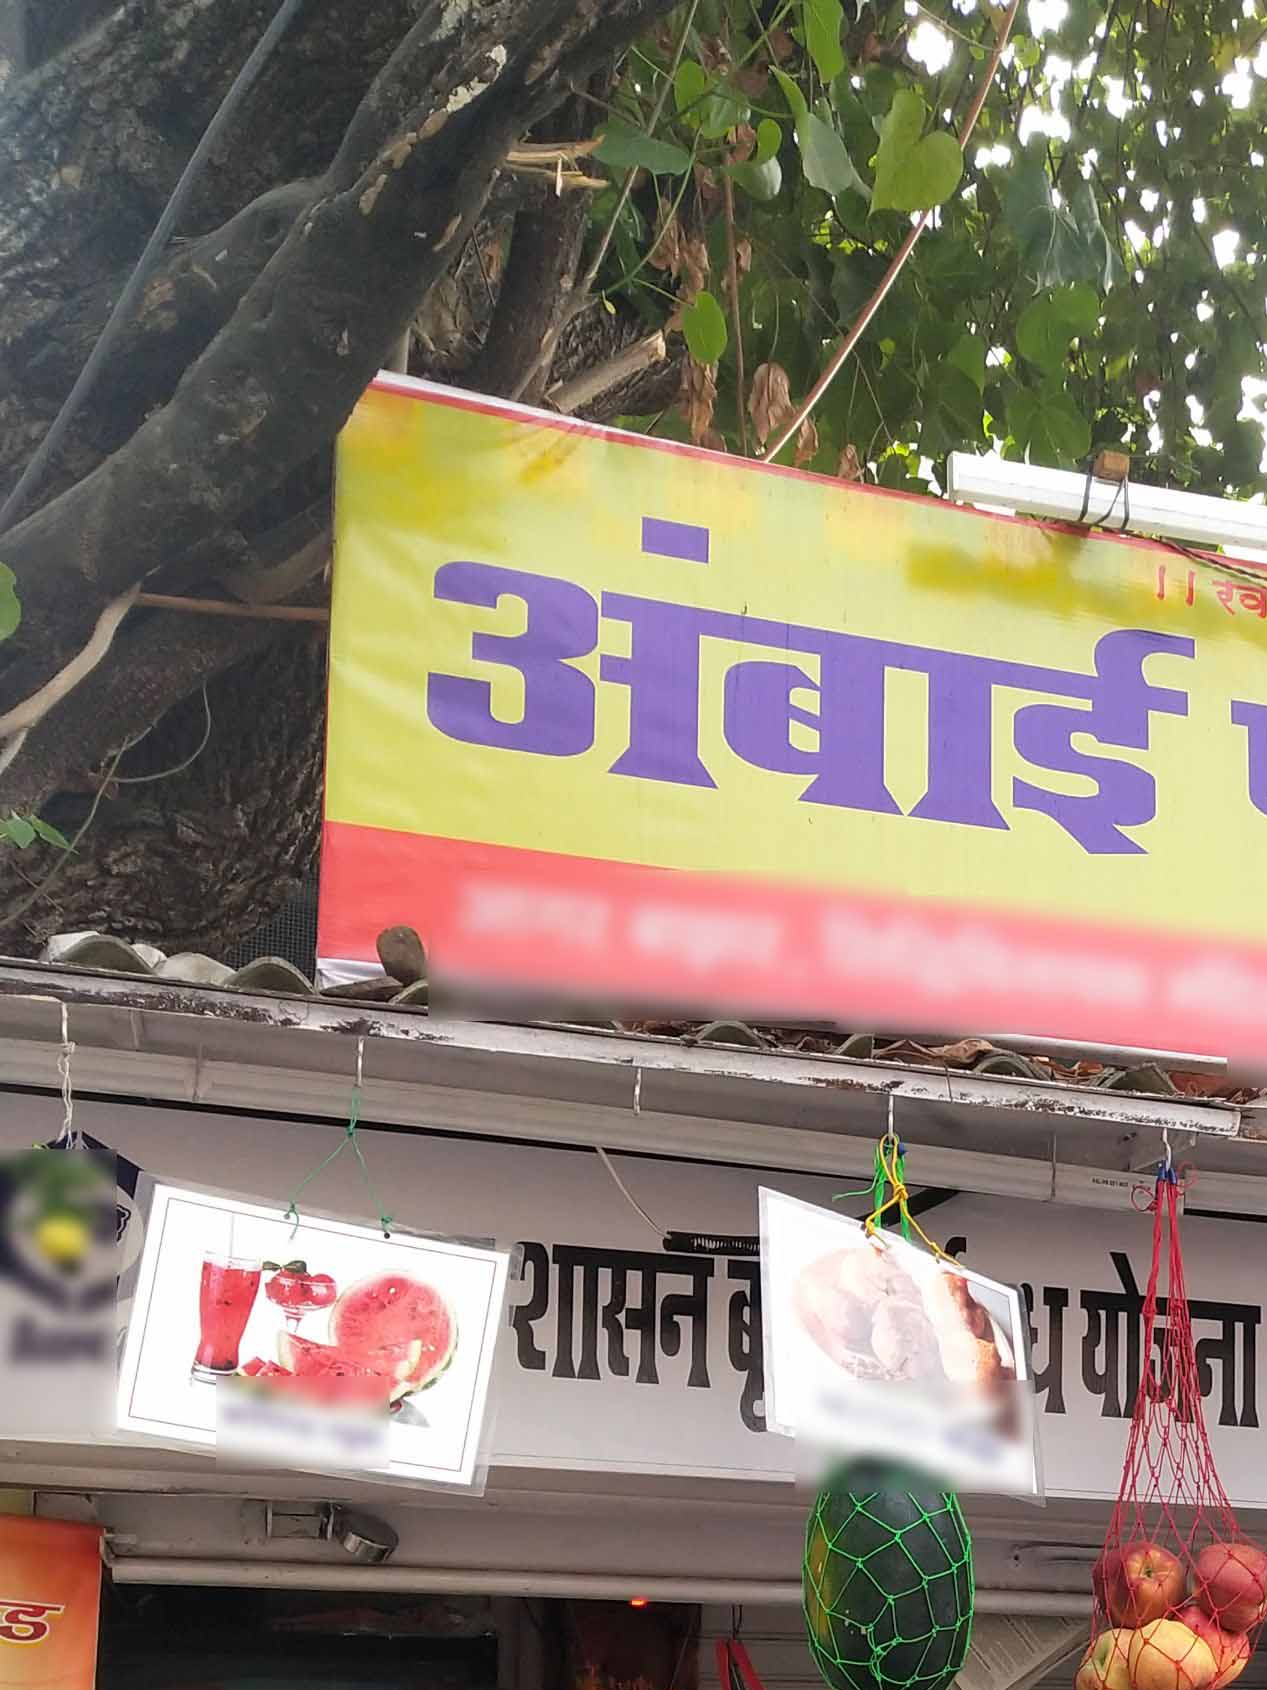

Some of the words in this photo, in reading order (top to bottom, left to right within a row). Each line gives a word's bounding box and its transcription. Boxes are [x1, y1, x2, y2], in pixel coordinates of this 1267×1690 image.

[427, 516, 1195, 854] अंबाई
[513, 1240, 715, 1389] शासन
[1079, 1251, 1262, 1429] योजना
